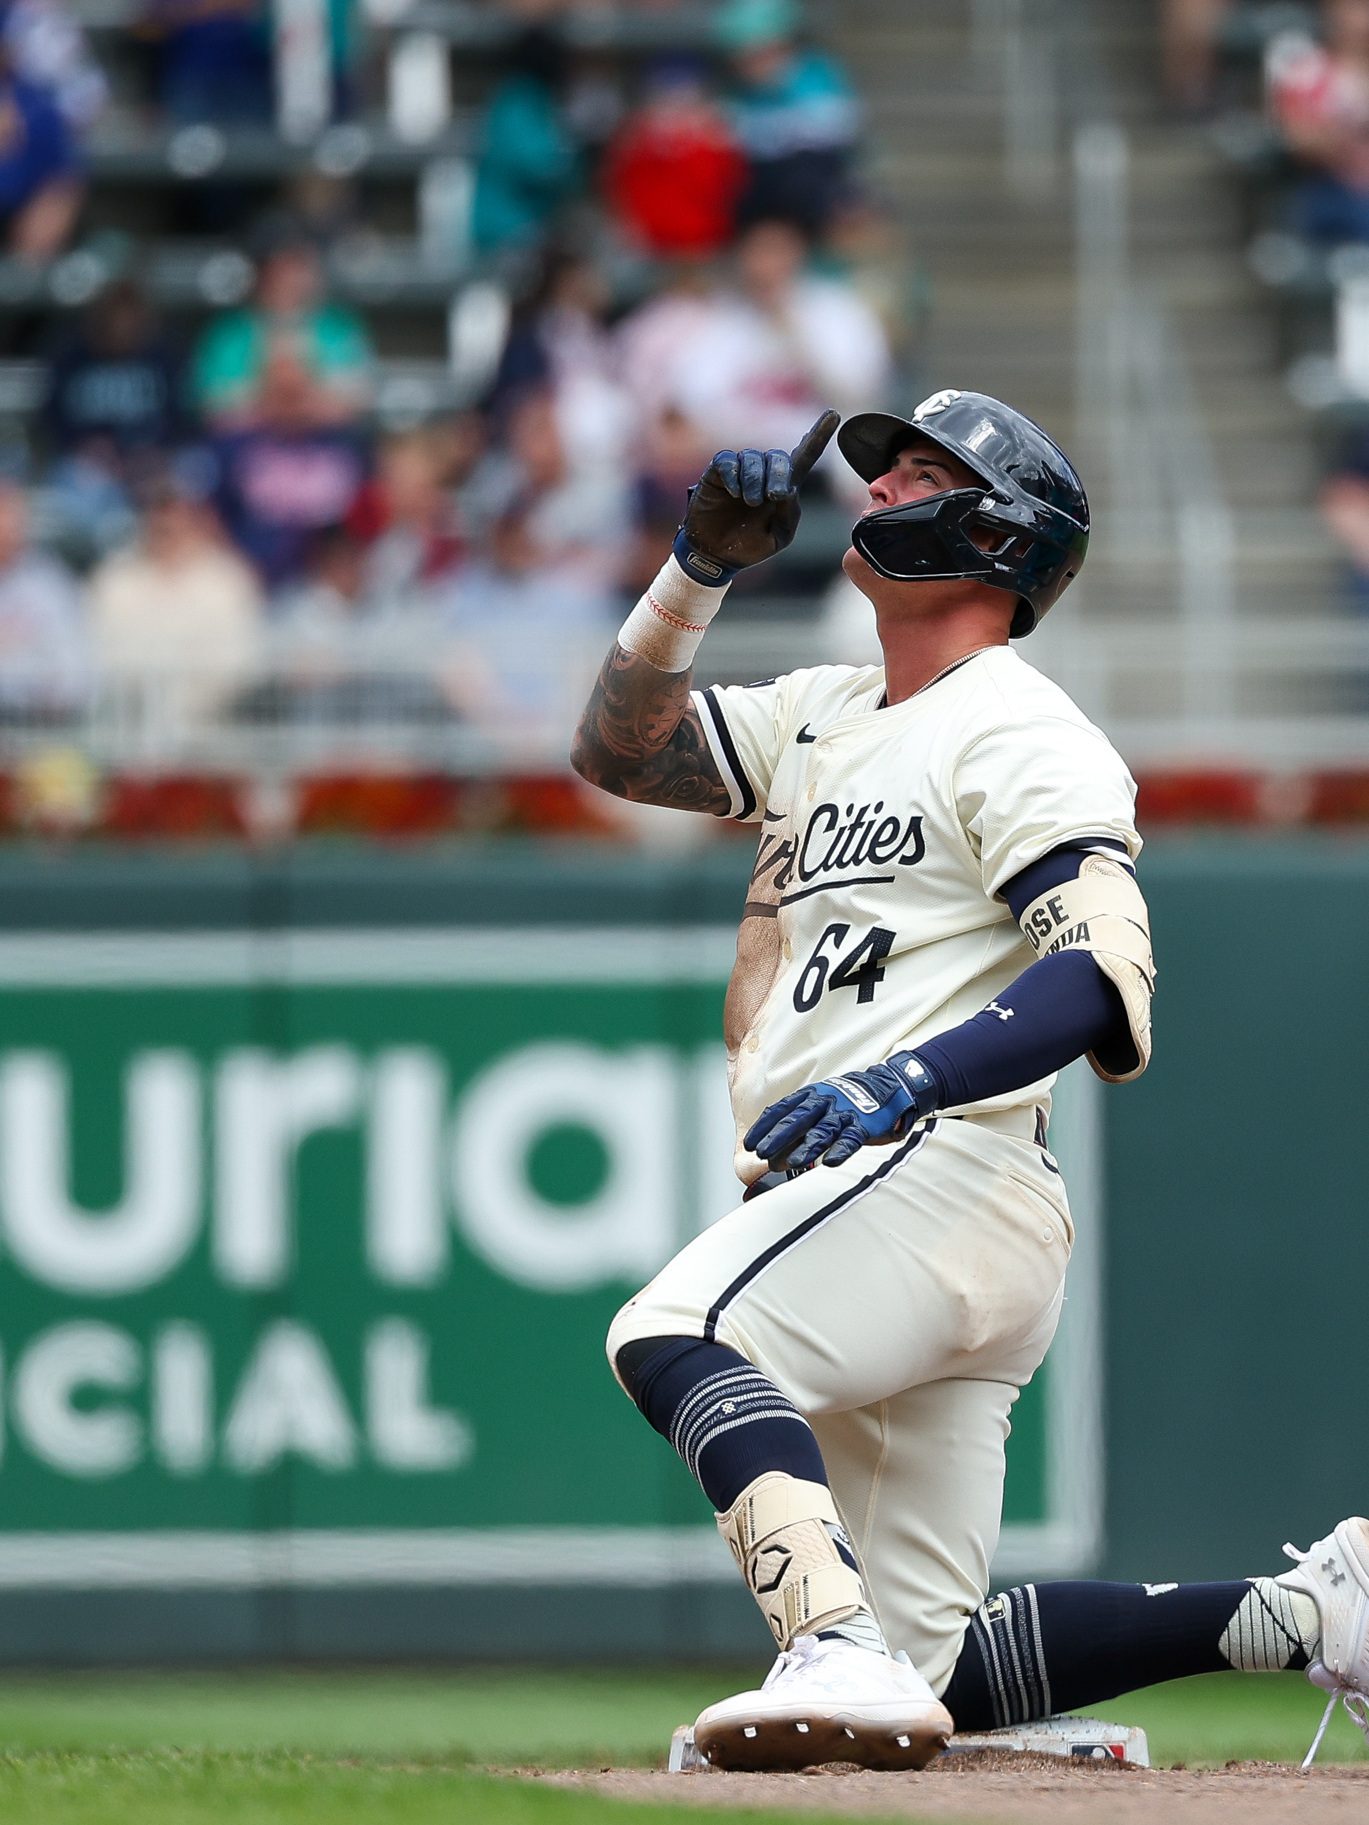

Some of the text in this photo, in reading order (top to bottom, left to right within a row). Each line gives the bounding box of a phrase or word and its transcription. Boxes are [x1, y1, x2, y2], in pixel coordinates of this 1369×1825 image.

[798, 801, 926, 883] Cities
[793, 923, 897, 1013] 64
[1045, 922, 1091, 957] NDA
[0, 1316, 478, 1481] CIAL
